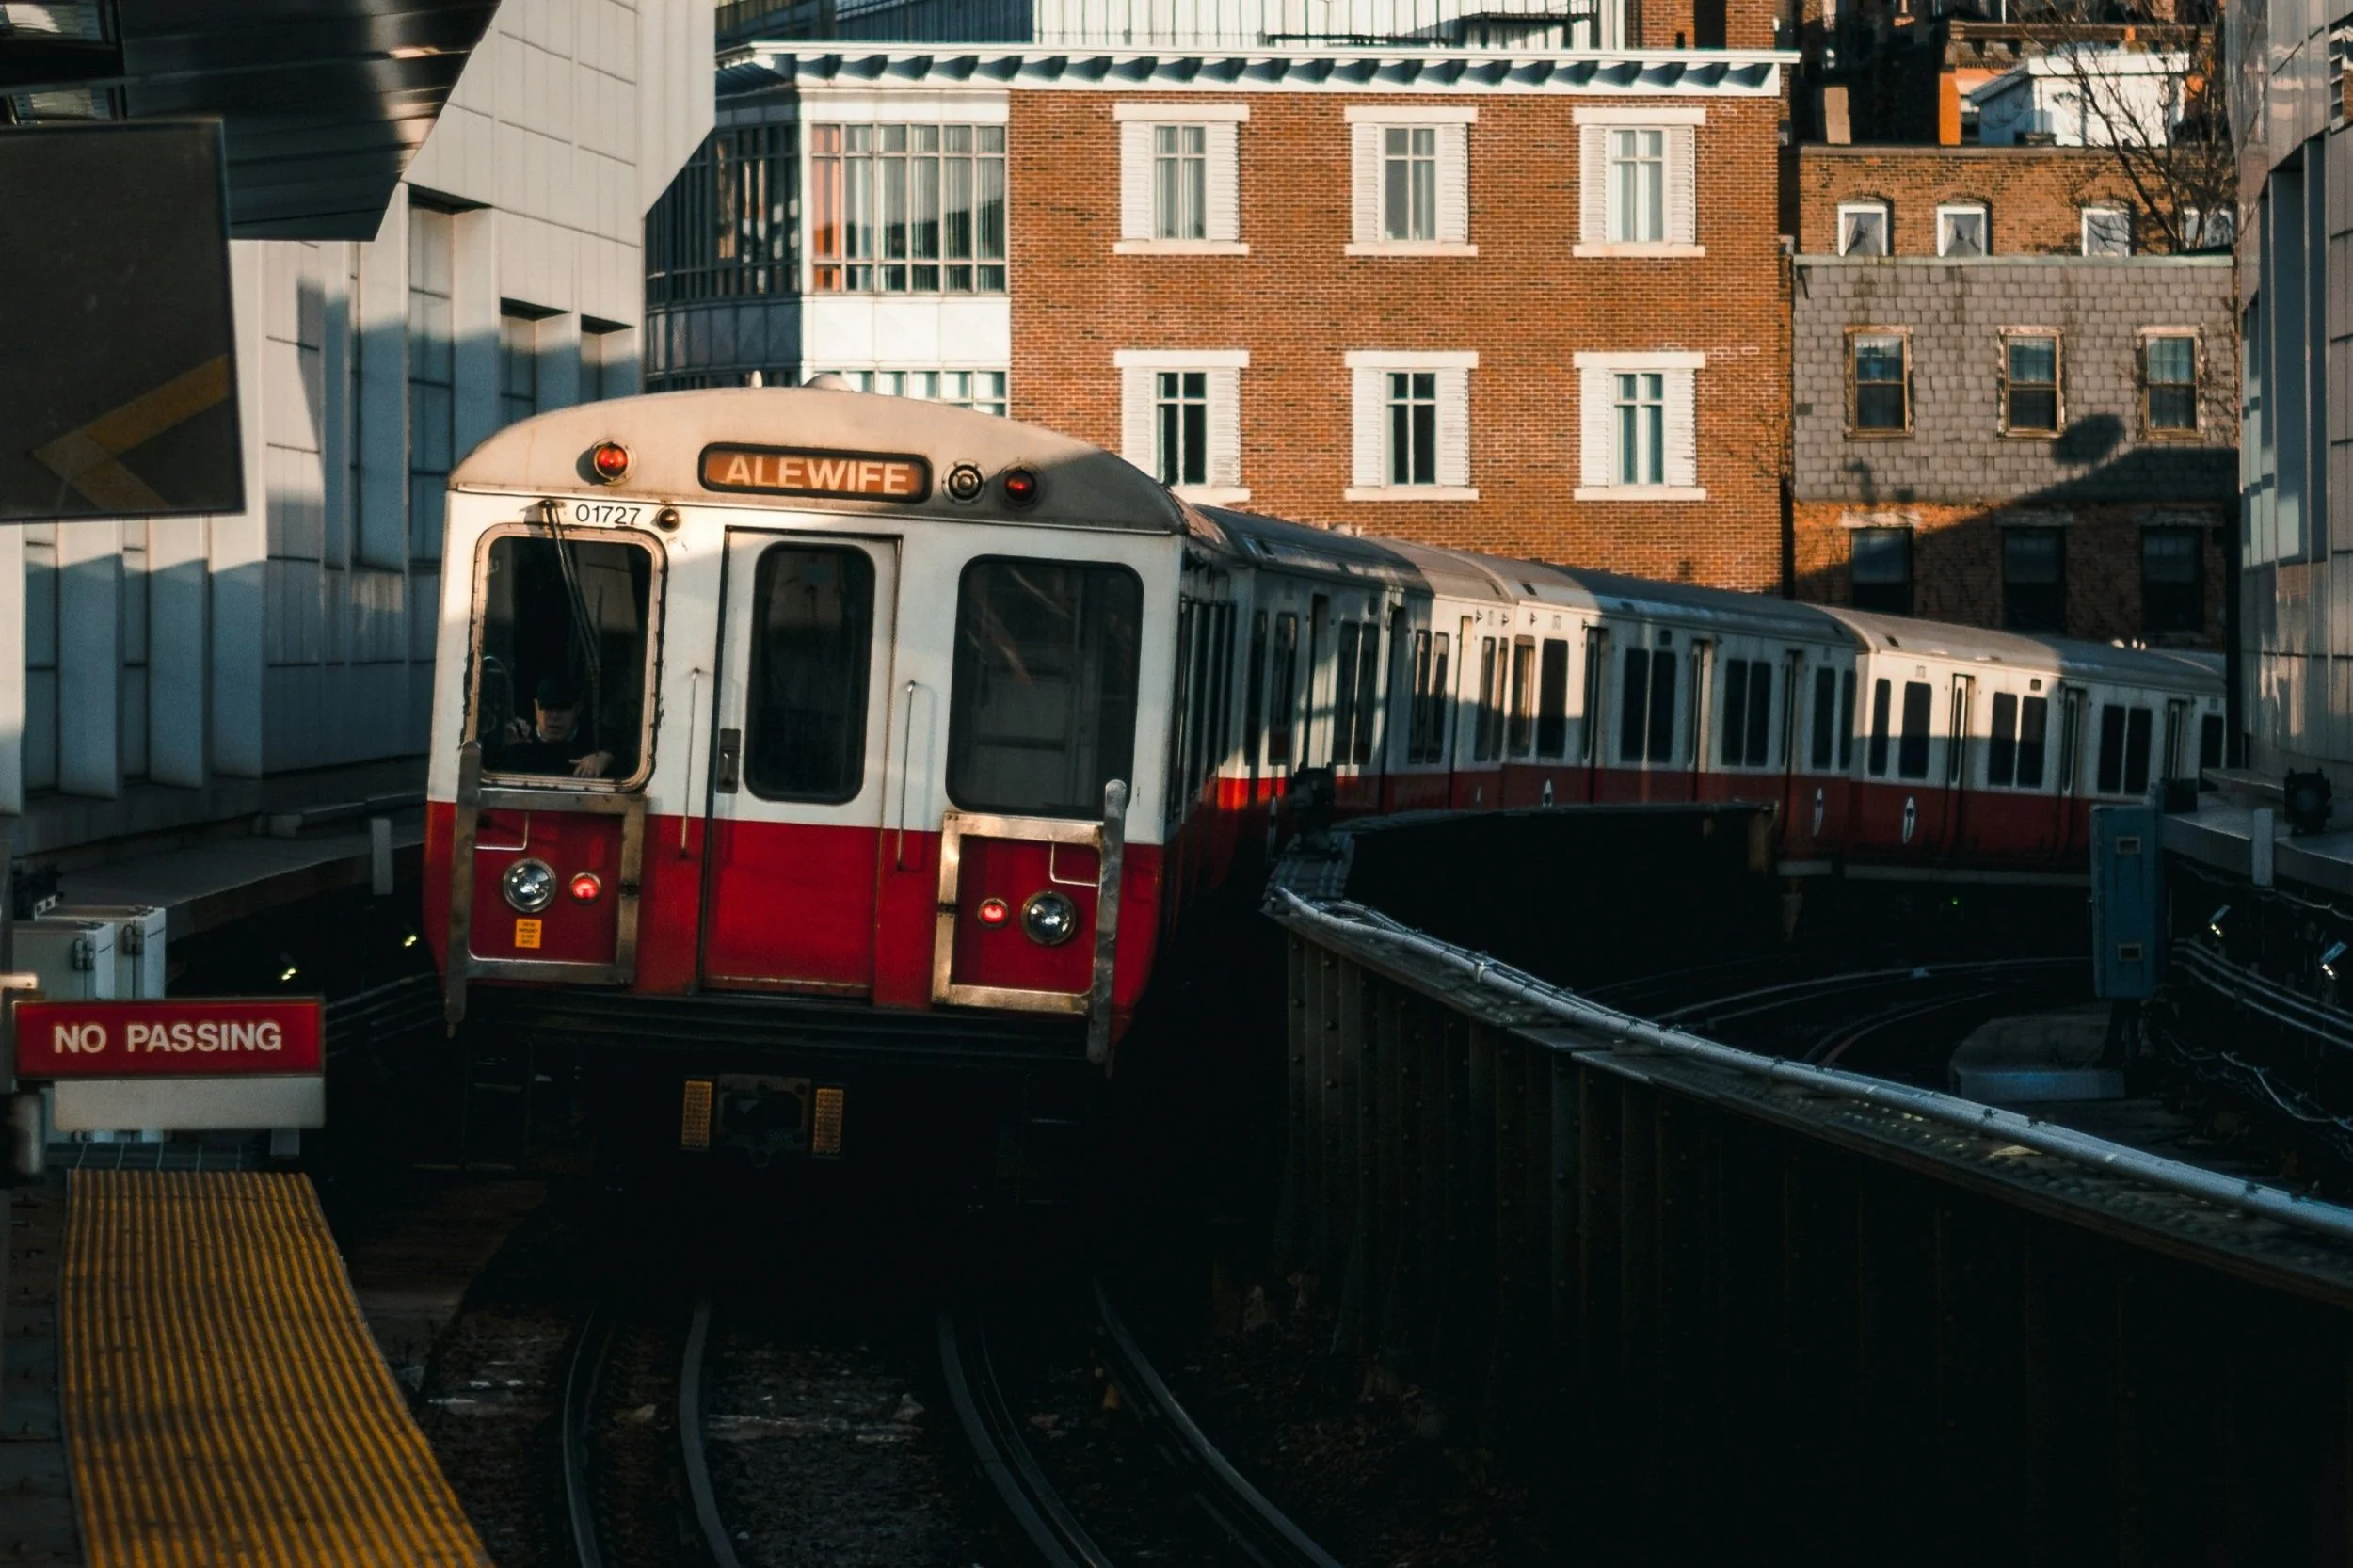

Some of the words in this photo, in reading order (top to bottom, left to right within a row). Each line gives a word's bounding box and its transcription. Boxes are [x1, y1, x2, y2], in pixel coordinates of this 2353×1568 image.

[725, 455, 909, 495] ALEWIFE
[576, 504, 642, 525] 01727
[54, 1025, 107, 1054] NO
[126, 1021, 281, 1053] PASSING
